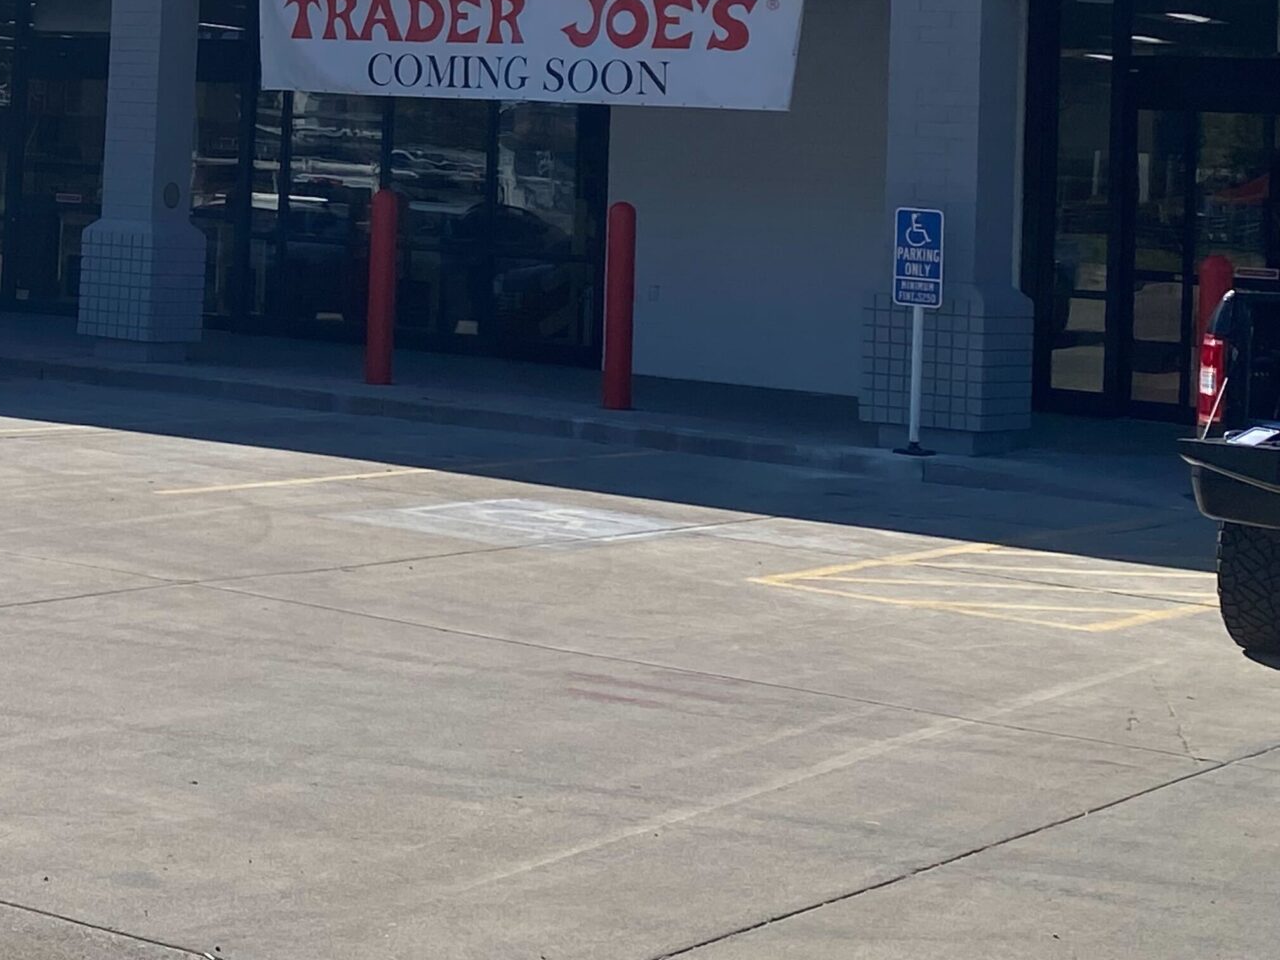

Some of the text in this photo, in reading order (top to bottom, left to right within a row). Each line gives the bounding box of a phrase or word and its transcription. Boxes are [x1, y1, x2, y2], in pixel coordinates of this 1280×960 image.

[367, 52, 670, 96] COMING SOON
[897, 246, 940, 263] PARKING
[904, 262, 932, 277] ONLY
